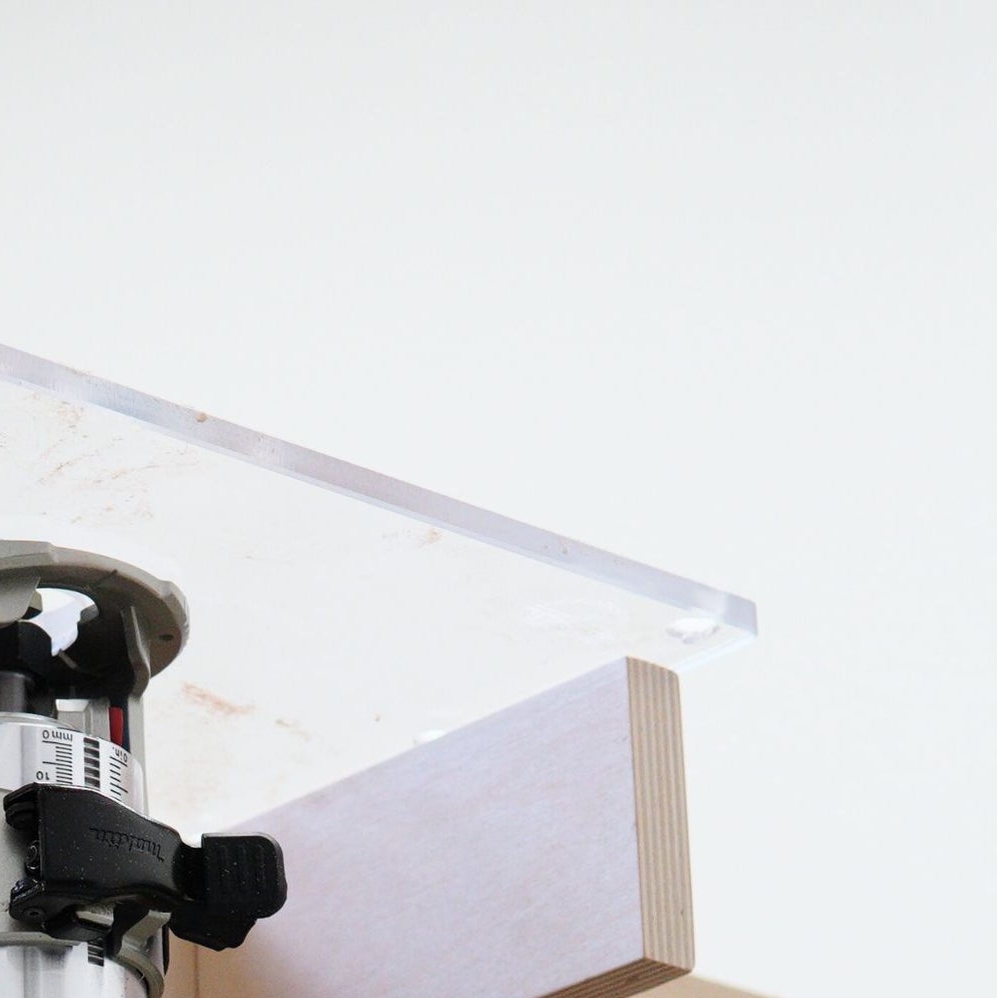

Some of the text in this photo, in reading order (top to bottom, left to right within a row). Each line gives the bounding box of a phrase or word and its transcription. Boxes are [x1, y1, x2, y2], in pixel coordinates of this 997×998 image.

[42, 729, 73, 742] mm 0
[35, 769, 50, 781] 10
